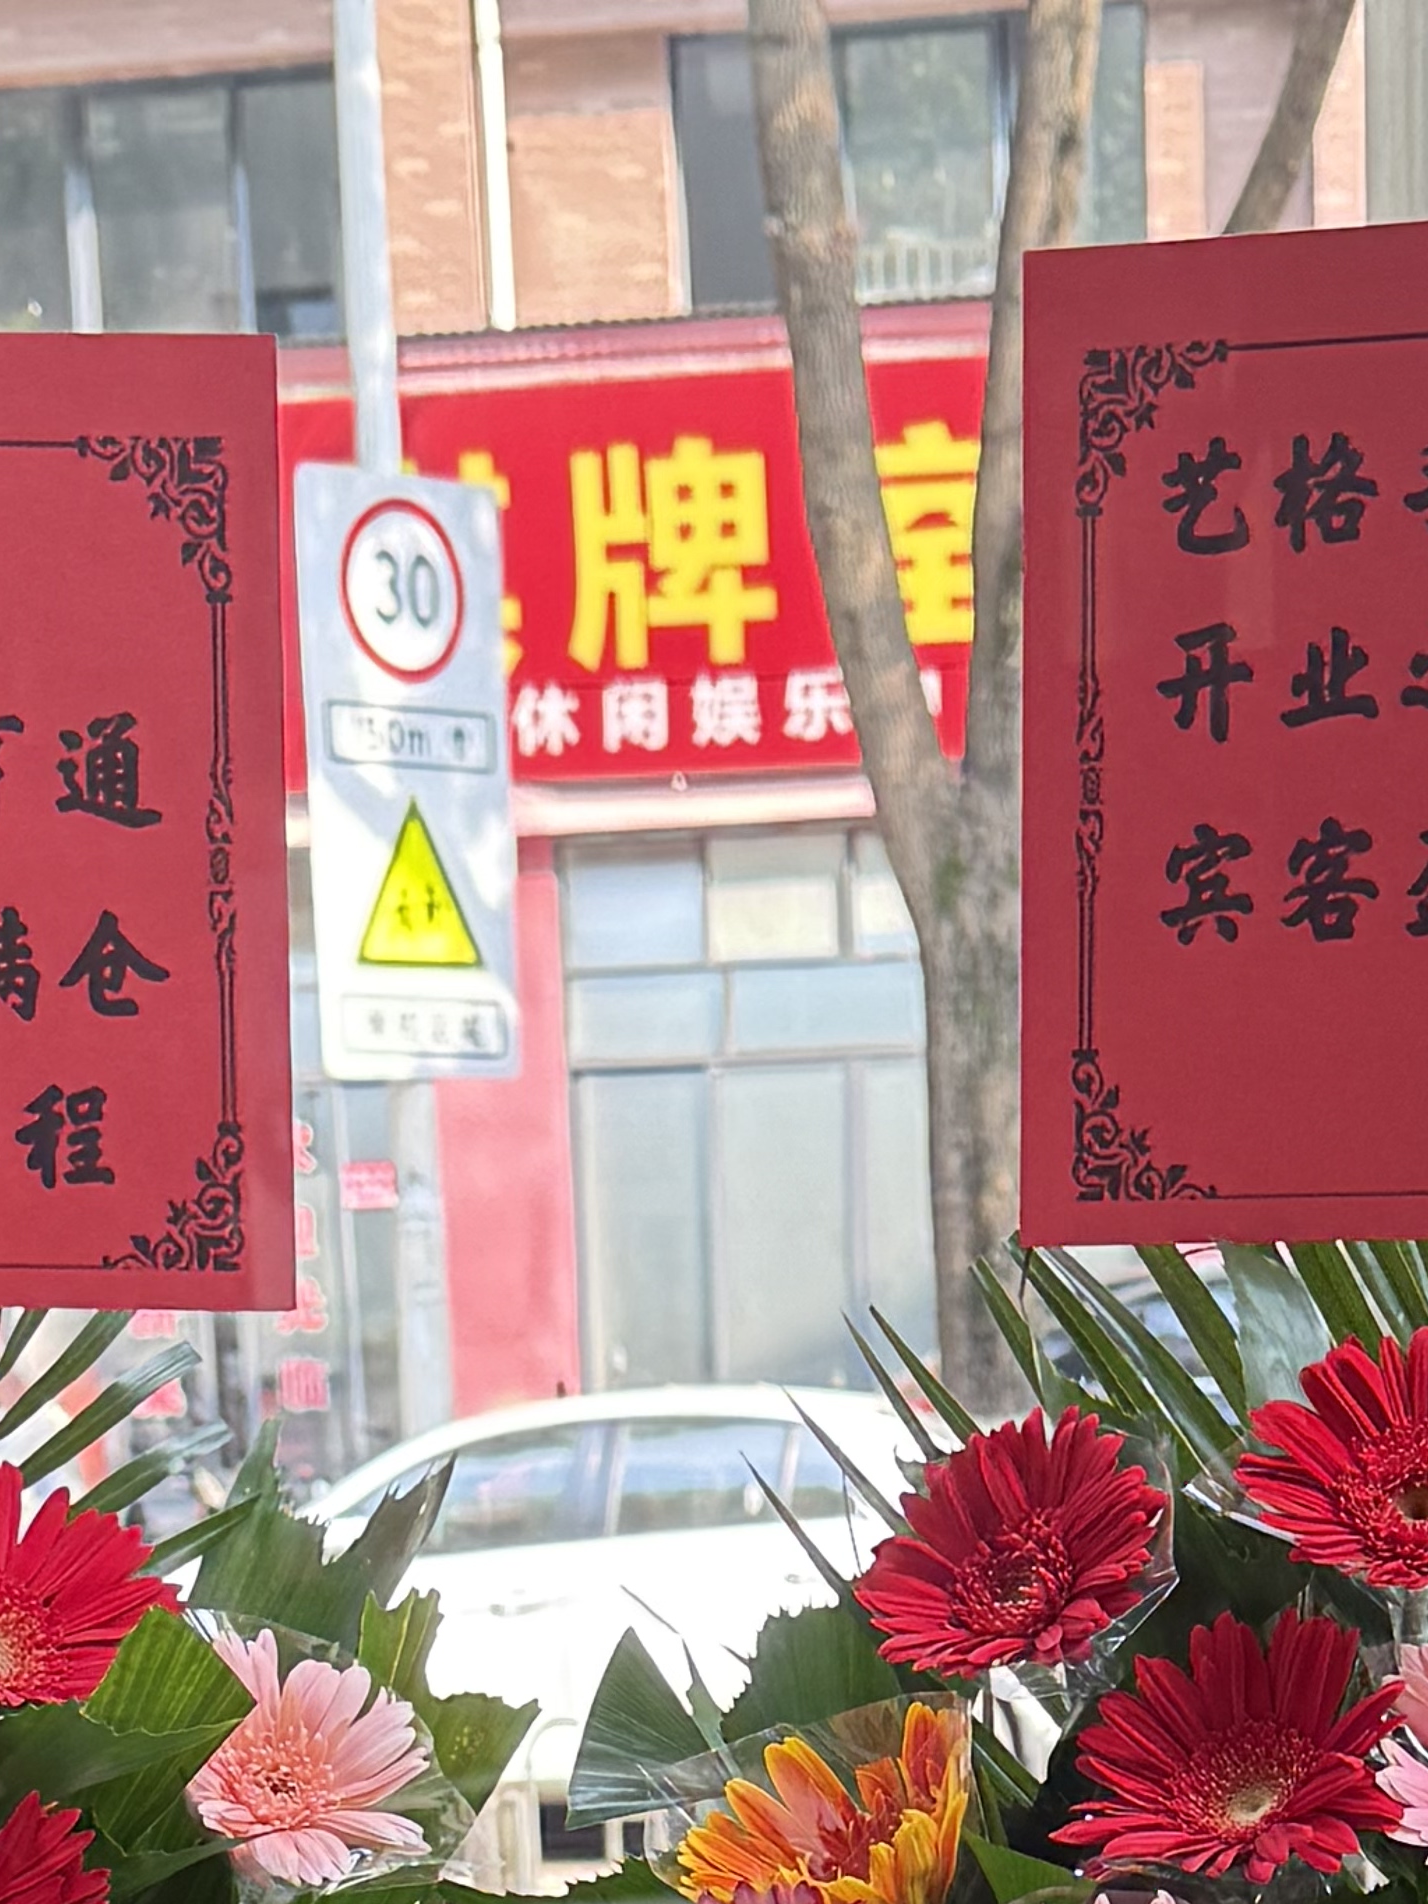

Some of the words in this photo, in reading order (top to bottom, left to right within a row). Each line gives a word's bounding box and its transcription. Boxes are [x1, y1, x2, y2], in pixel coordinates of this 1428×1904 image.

[375, 549, 440, 629] 30
[512, 667, 941, 757] 休闲娱乐
